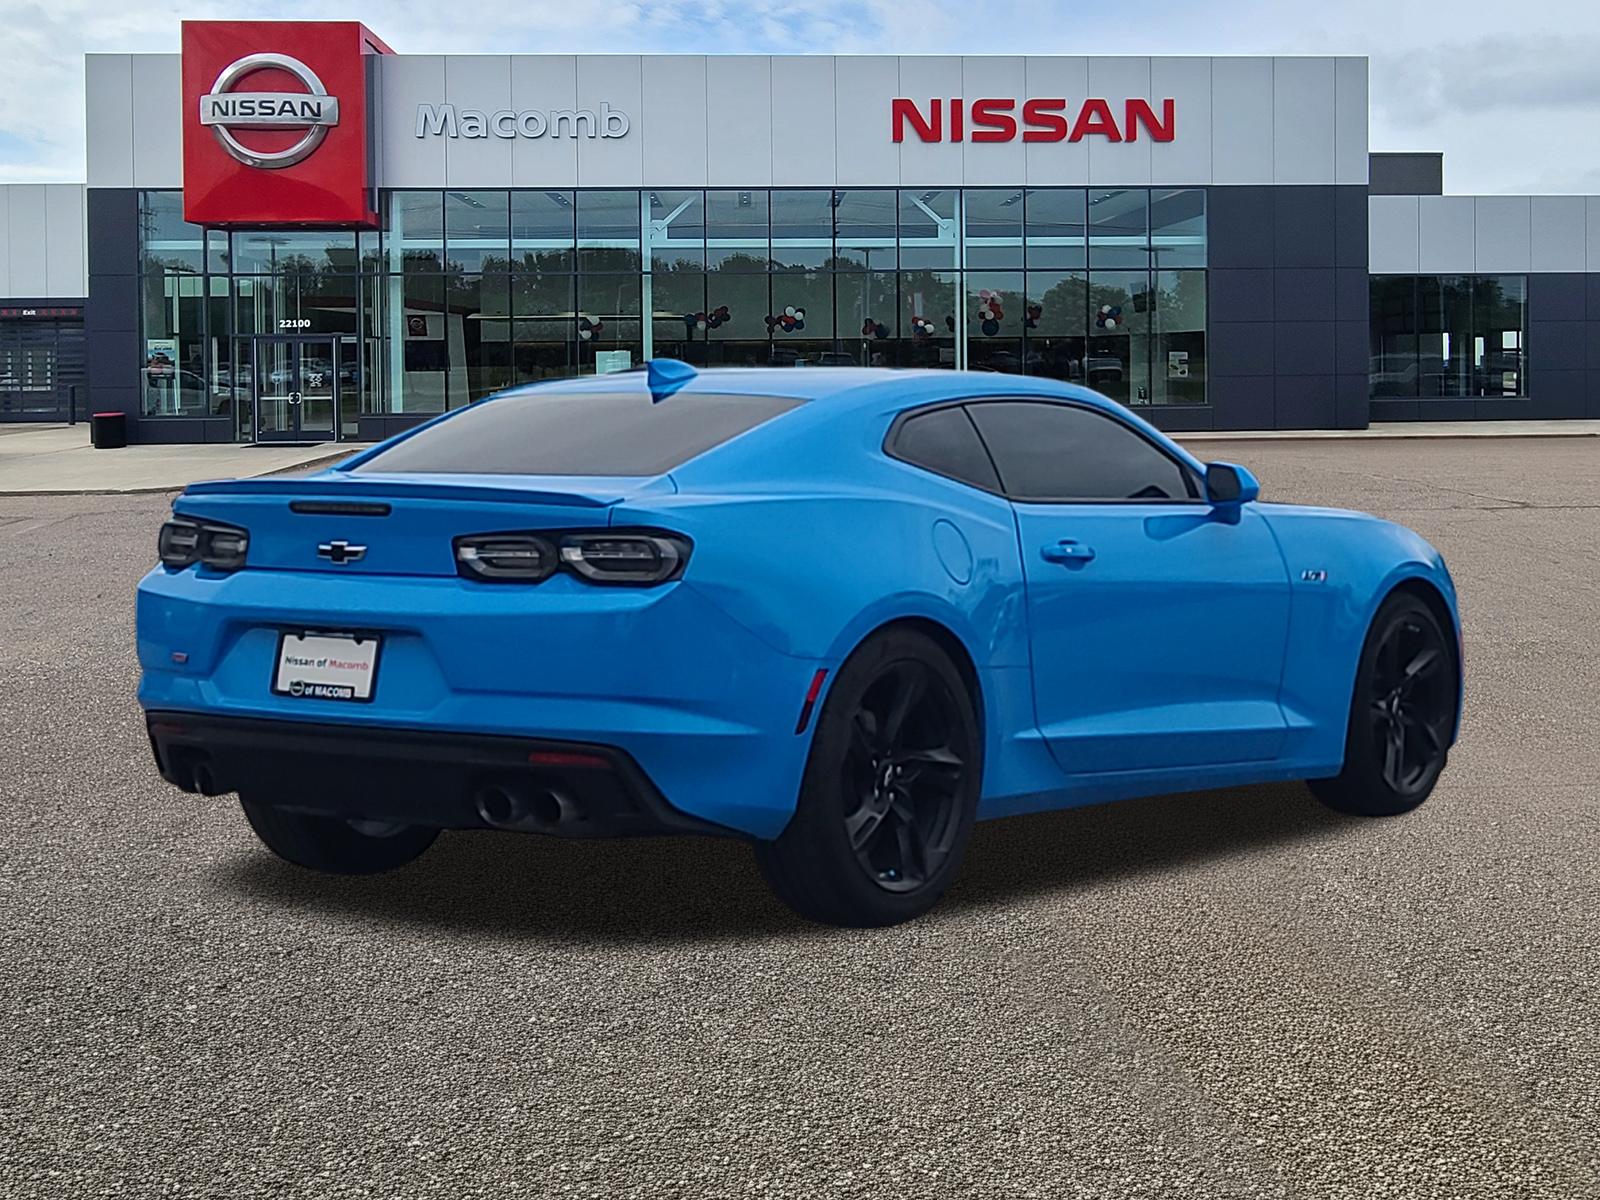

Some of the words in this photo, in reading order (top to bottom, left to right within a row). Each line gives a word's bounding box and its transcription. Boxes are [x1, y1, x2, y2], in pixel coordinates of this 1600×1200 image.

[211, 99, 322, 117] NISSAN
[414, 102, 631, 140] Macomb
[892, 98, 1176, 143] NISSAN
[279, 319, 311, 328] 22100
[285, 656, 315, 667] Nissan
[316, 658, 328, 668] of
[329, 660, 369, 671] Macomb
[305, 686, 314, 696] of
[314, 686, 352, 698] MACOMB
